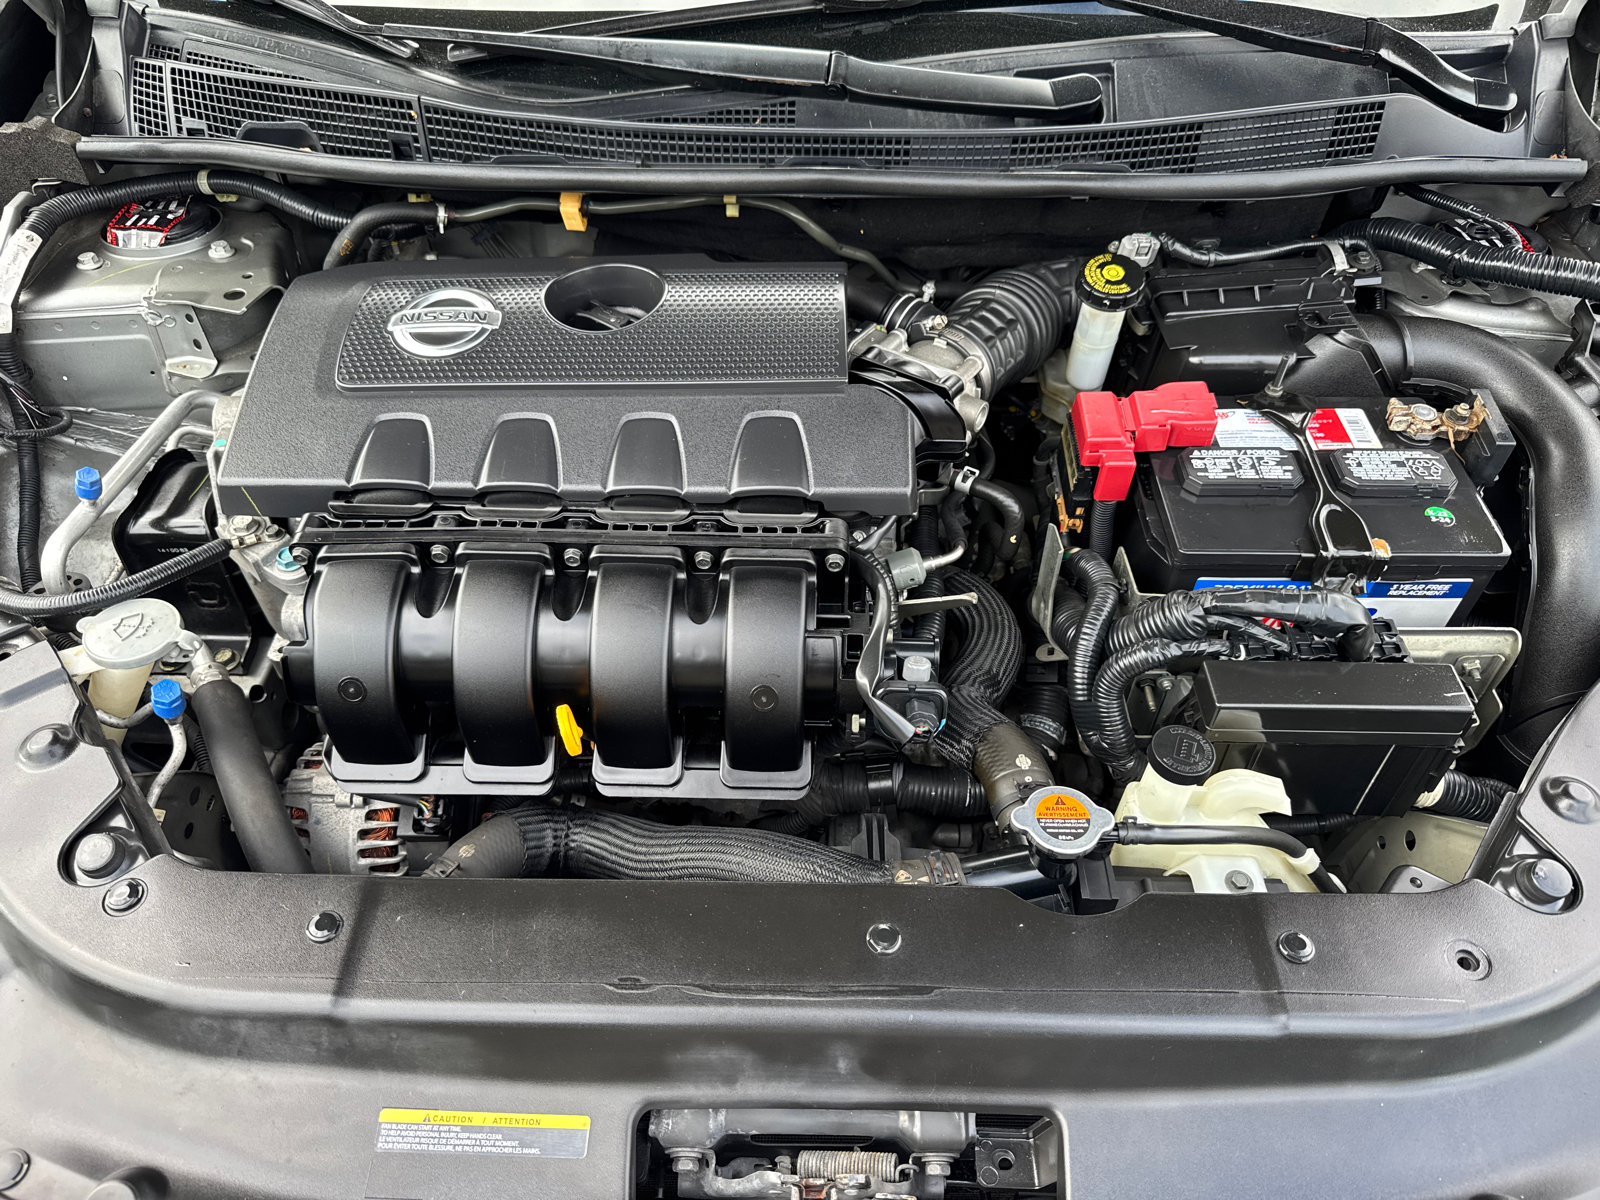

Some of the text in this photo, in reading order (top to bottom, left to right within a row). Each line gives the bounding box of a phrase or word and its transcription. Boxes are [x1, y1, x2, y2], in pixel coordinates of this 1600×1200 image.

[399, 311, 488, 324] NISSAN
[432, 1115, 474, 1123] CAUTION
[492, 1117, 541, 1126] ATTENTION
